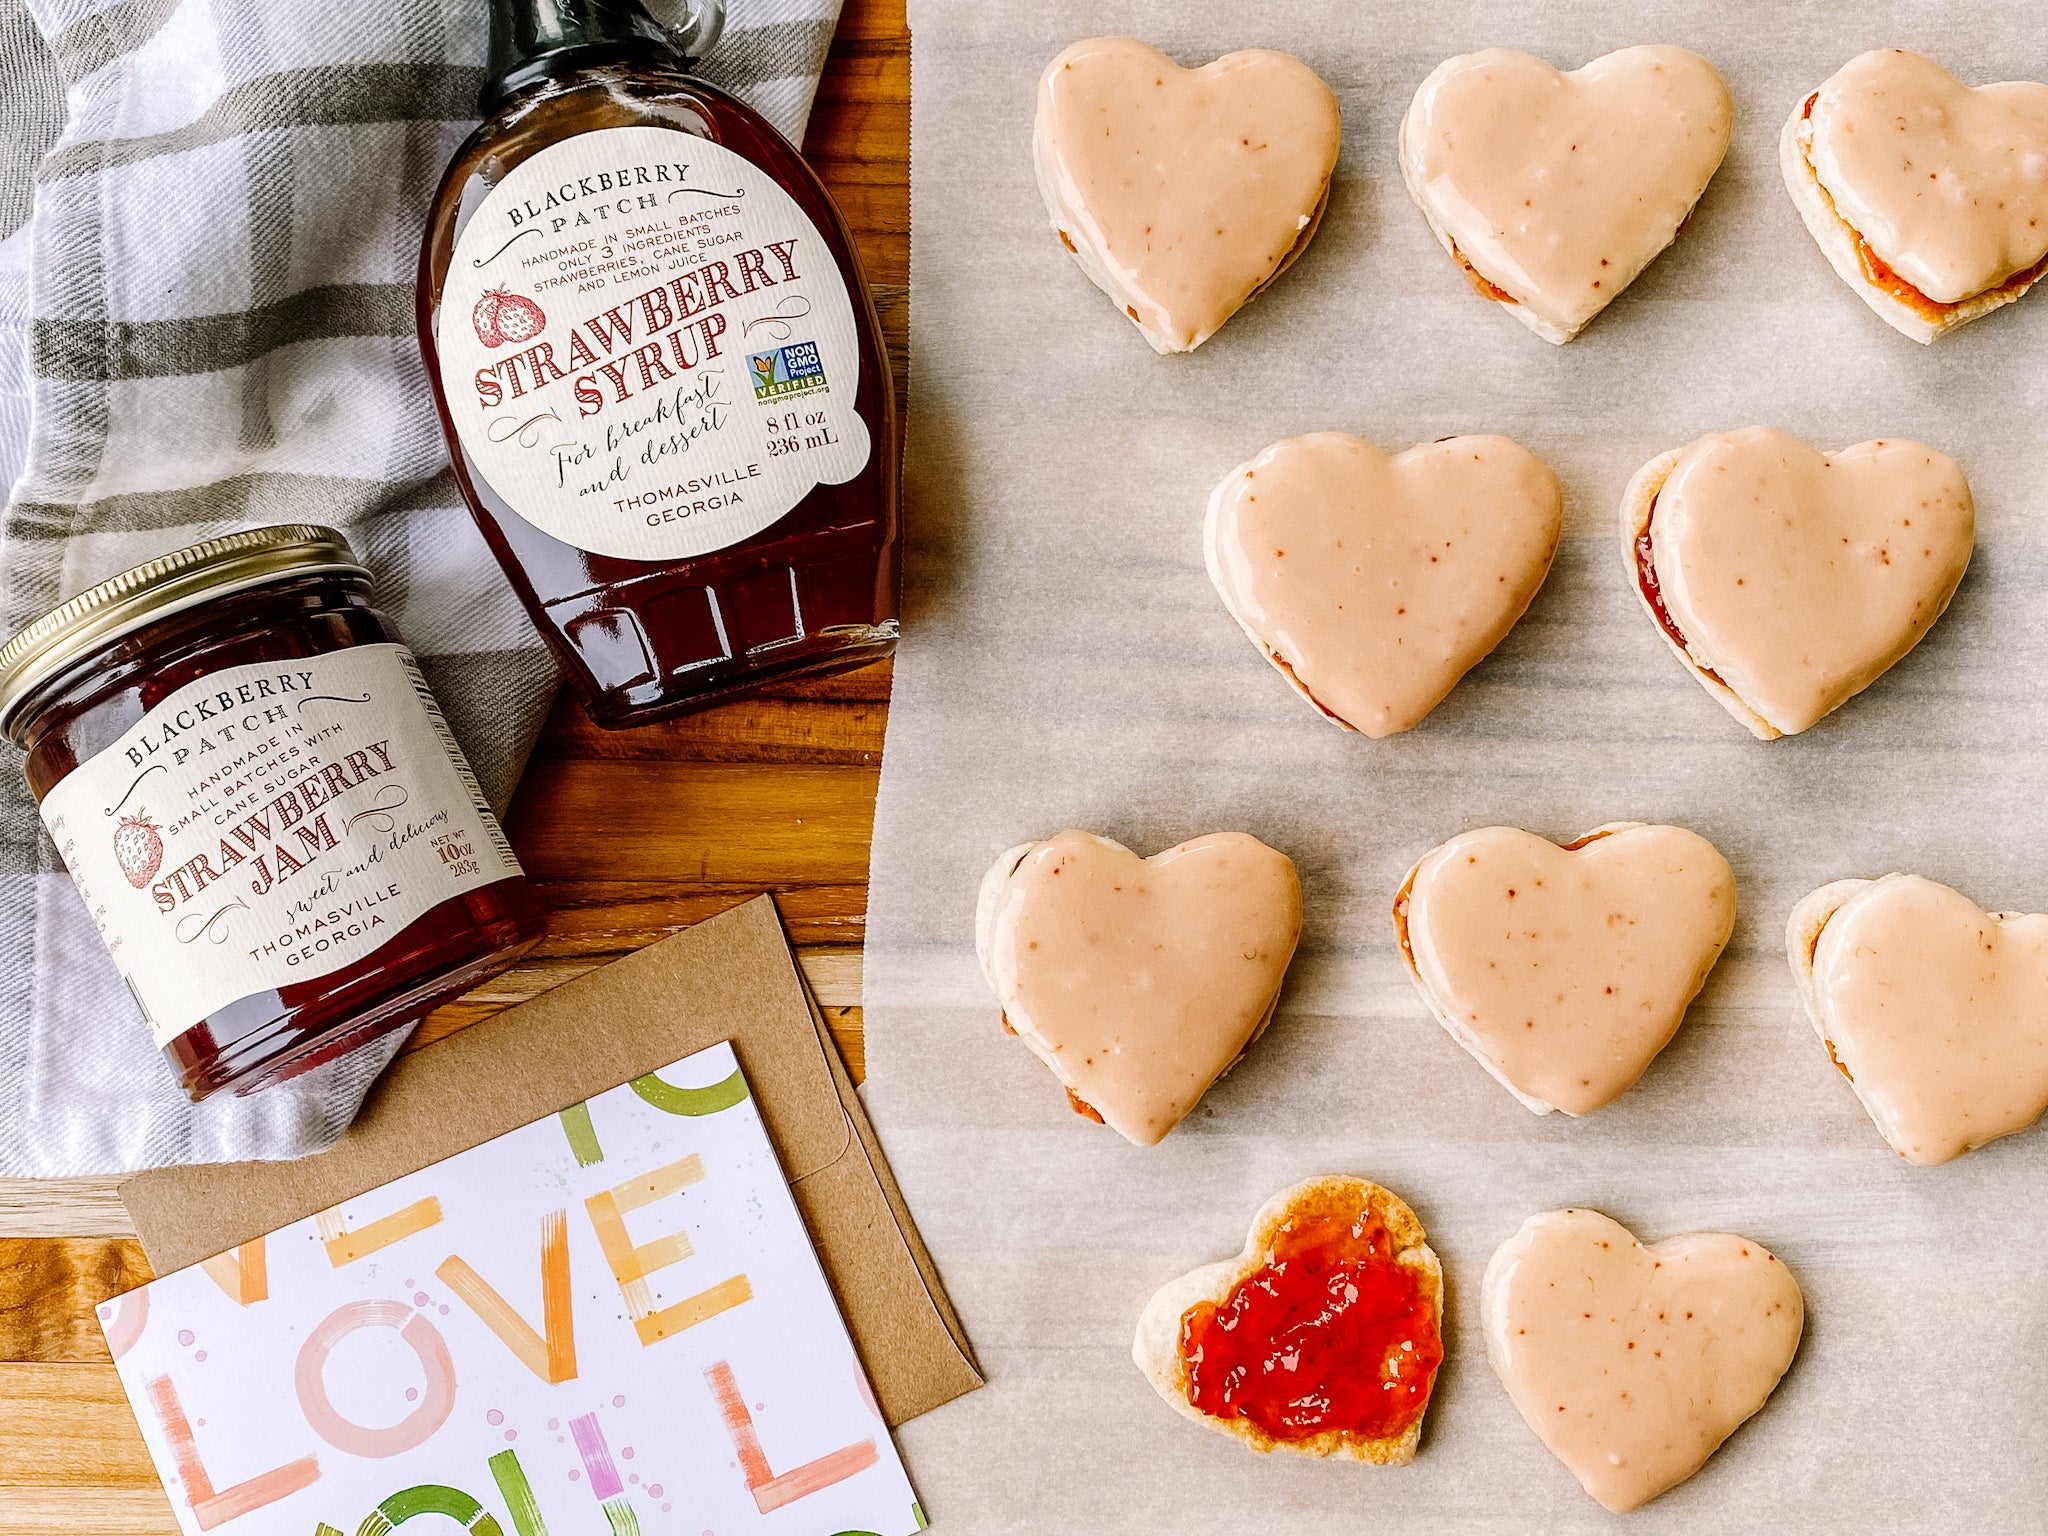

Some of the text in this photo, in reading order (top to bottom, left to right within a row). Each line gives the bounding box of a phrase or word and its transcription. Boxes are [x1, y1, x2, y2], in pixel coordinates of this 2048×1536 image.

[507, 164, 690, 228] BLACKBERRY
[551, 193, 658, 232] PATCH
[522, 204, 741, 269] HANDMADE IN SMALL BATCHES
[534, 231, 743, 293] STRAWBERRIES, CANE SUGAR
[558, 225, 711, 271] ONLY 3 INGREDIENTS
[578, 253, 708, 294] AND LEMON JUICE
[475, 239, 800, 410] STRAWBERRY
[784, 344, 815, 359] NON
[574, 313, 727, 420] SYRUP
[758, 375, 824, 397] VERIFIED
[788, 354, 818, 368] GMO
[790, 364, 822, 377] Project
[758, 386, 830, 406] nongmoproject.org
[766, 411, 827, 434] 8 fl oz
[550, 369, 725, 488] For breakfast
[579, 401, 731, 497] and dessert
[767, 427, 839, 457] 236 mL
[614, 463, 762, 513] THOMASVILLE
[646, 491, 744, 527] GEORGIA
[125, 672, 314, 768] BLACKBERRY
[172, 704, 289, 767] PATCH
[168, 722, 344, 836] SMALL BATCHES WITH
[187, 722, 304, 799] HANDMADE IN
[214, 755, 322, 826] CANE SUGAR
[151, 740, 397, 917] STRAWBERRY
[250, 812, 341, 895] JAM
[430, 829, 466, 848] NET WT
[286, 868, 343, 925] sweet
[346, 845, 384, 877] and
[389, 808, 449, 851] delicious
[450, 859, 481, 878] 283g
[249, 883, 401, 962] THOMASVILLE
[286, 914, 386, 967] GEORGIA
[146, 1152, 755, 1532] LOVE
